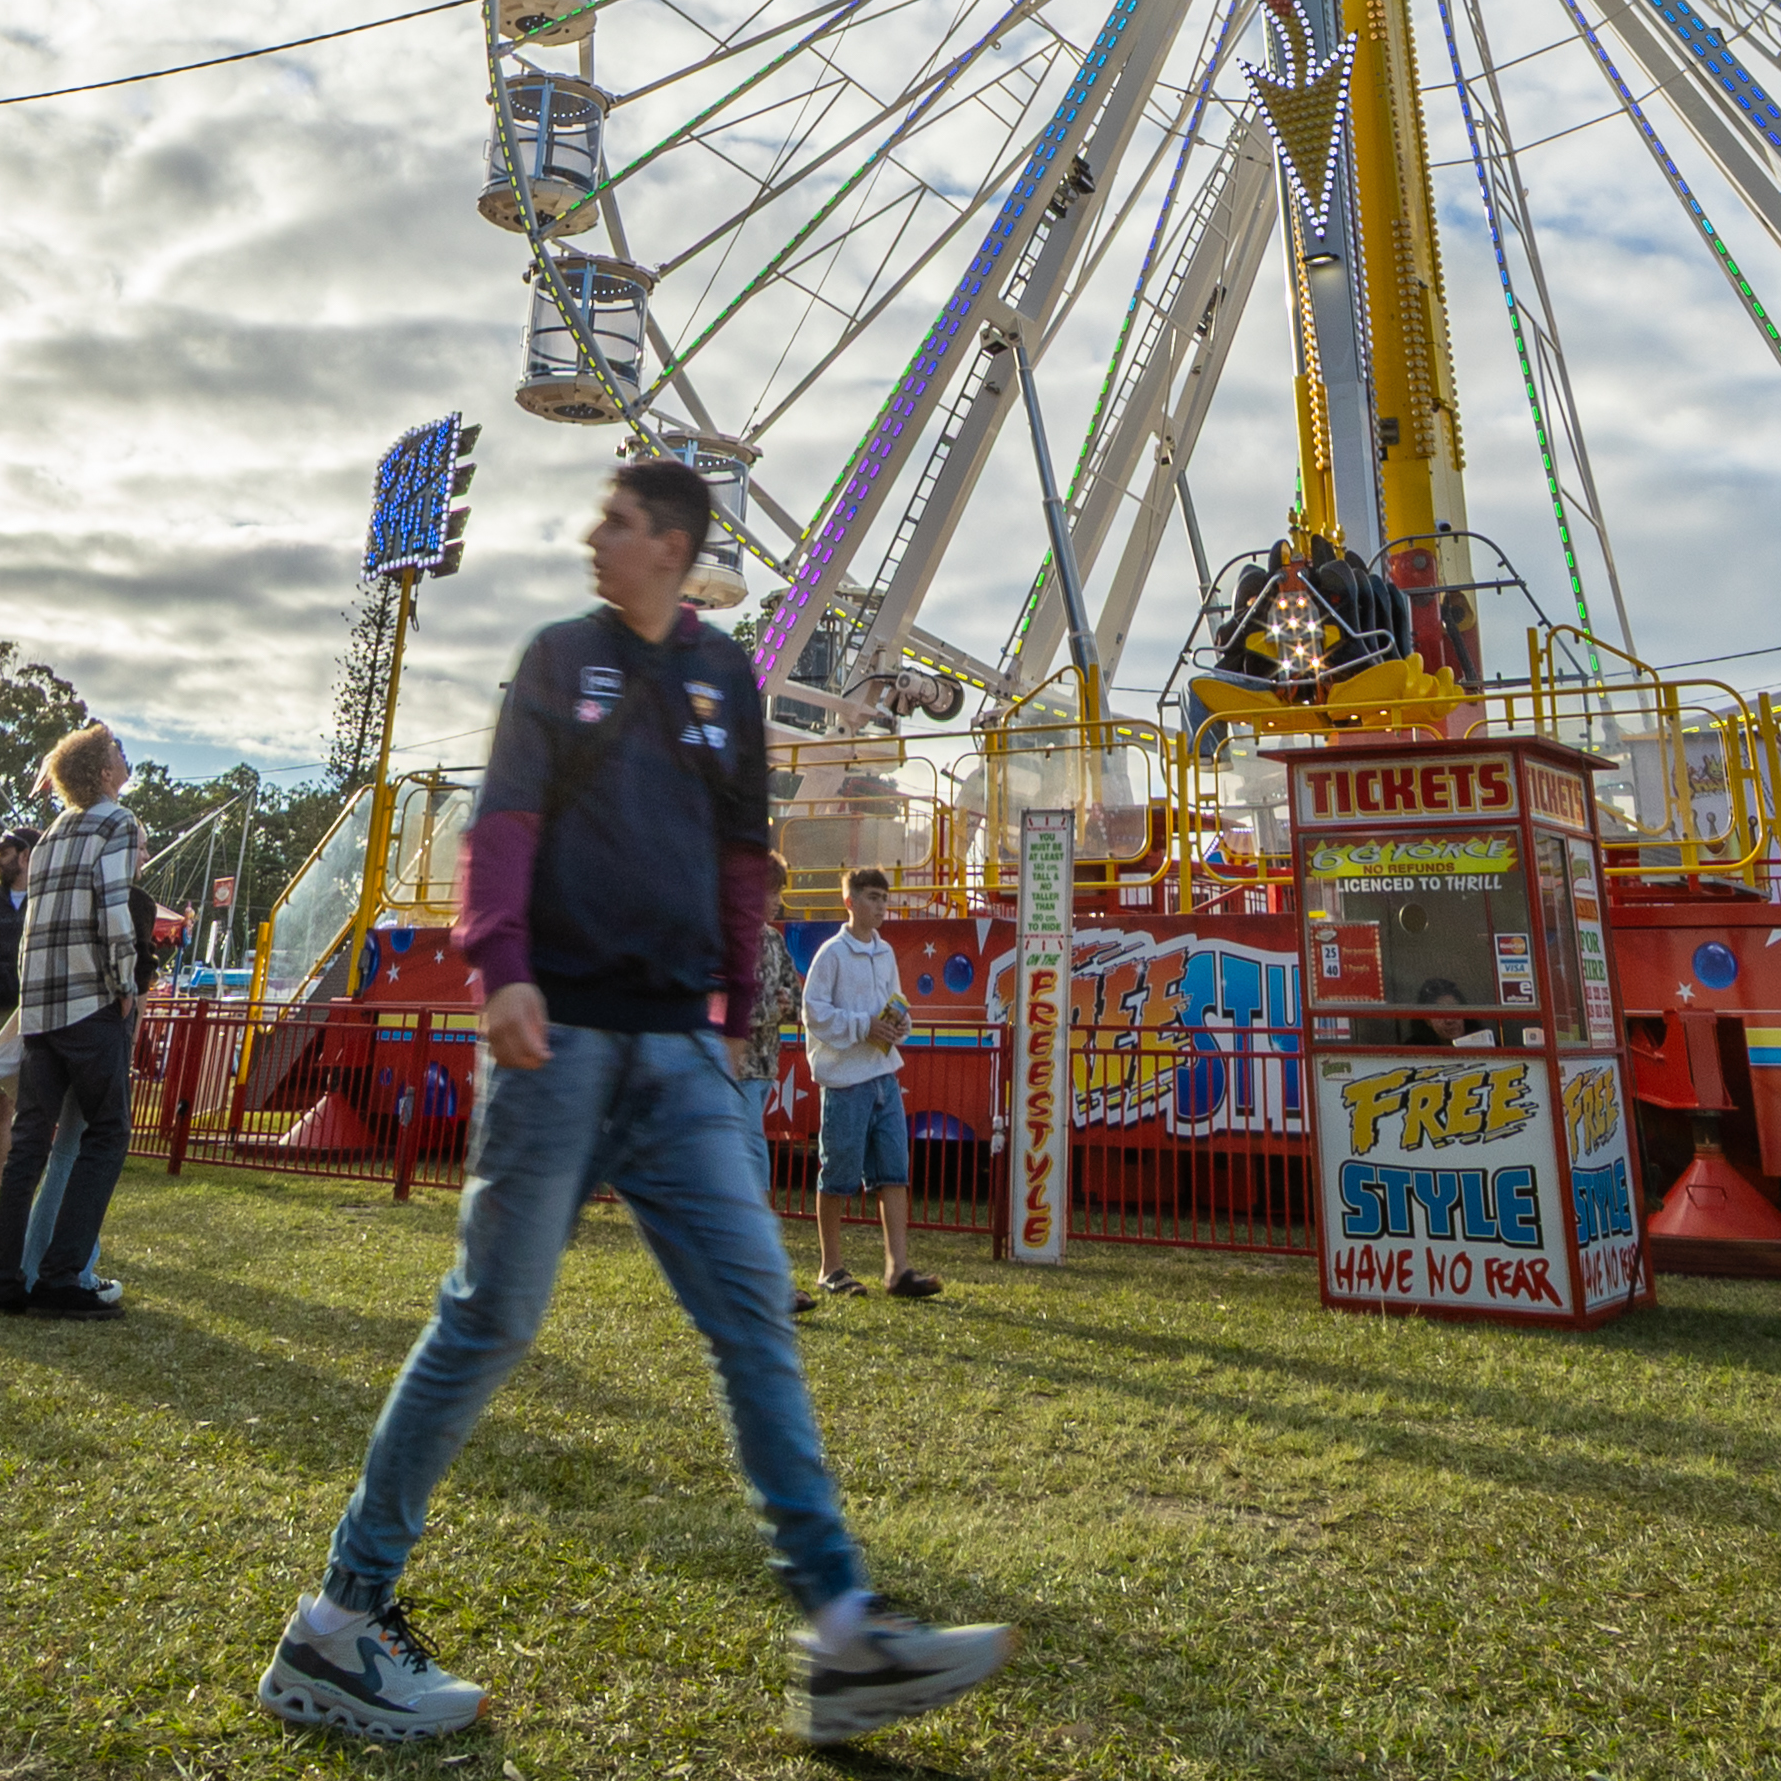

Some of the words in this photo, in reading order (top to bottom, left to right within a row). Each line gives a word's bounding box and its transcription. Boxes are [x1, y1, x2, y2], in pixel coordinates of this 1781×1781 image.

[1307, 762, 1513, 818] TICKETS
[1039, 833, 1055, 841] YOU
[1030, 843, 1050, 851] MUST
[1053, 843, 1062, 851] BE
[1391, 839, 1508, 862] FORCE
[1029, 852, 1038, 861] AT
[1041, 853, 1064, 861] LEAST
[1363, 865, 1384, 875] NO
[1388, 862, 1455, 874] REFUNDS
[1040, 883, 1052, 891] NO
[1336, 876, 1415, 893] LICENCED
[1418, 877, 1441, 891] TO
[1445, 874, 1503, 892] THRILL
[1032, 893, 1059, 901] TALLER
[1028, 923, 1039, 931] TO
[1041, 923, 1062, 931] RIDE
[1026, 953, 1041, 966] ON
[1043, 953, 1062, 967] THE
[1325, 947, 1337, 959] 25
[1326, 965, 1338, 976] 40
[1504, 963, 1525, 972] VISA
[1023, 970, 1058, 1248] FREESTYLE
[1340, 1063, 1539, 1156] FREE
[1562, 1067, 1619, 1164] FREE
[1339, 1159, 1544, 1250] STYLE
[1571, 1157, 1633, 1249] STYLE
[1603, 1244, 1619, 1290] NO
[1334, 1244, 1414, 1294] HAVE
[1425, 1246, 1473, 1297] NO
[1484, 1256, 1564, 1307] FEAR
